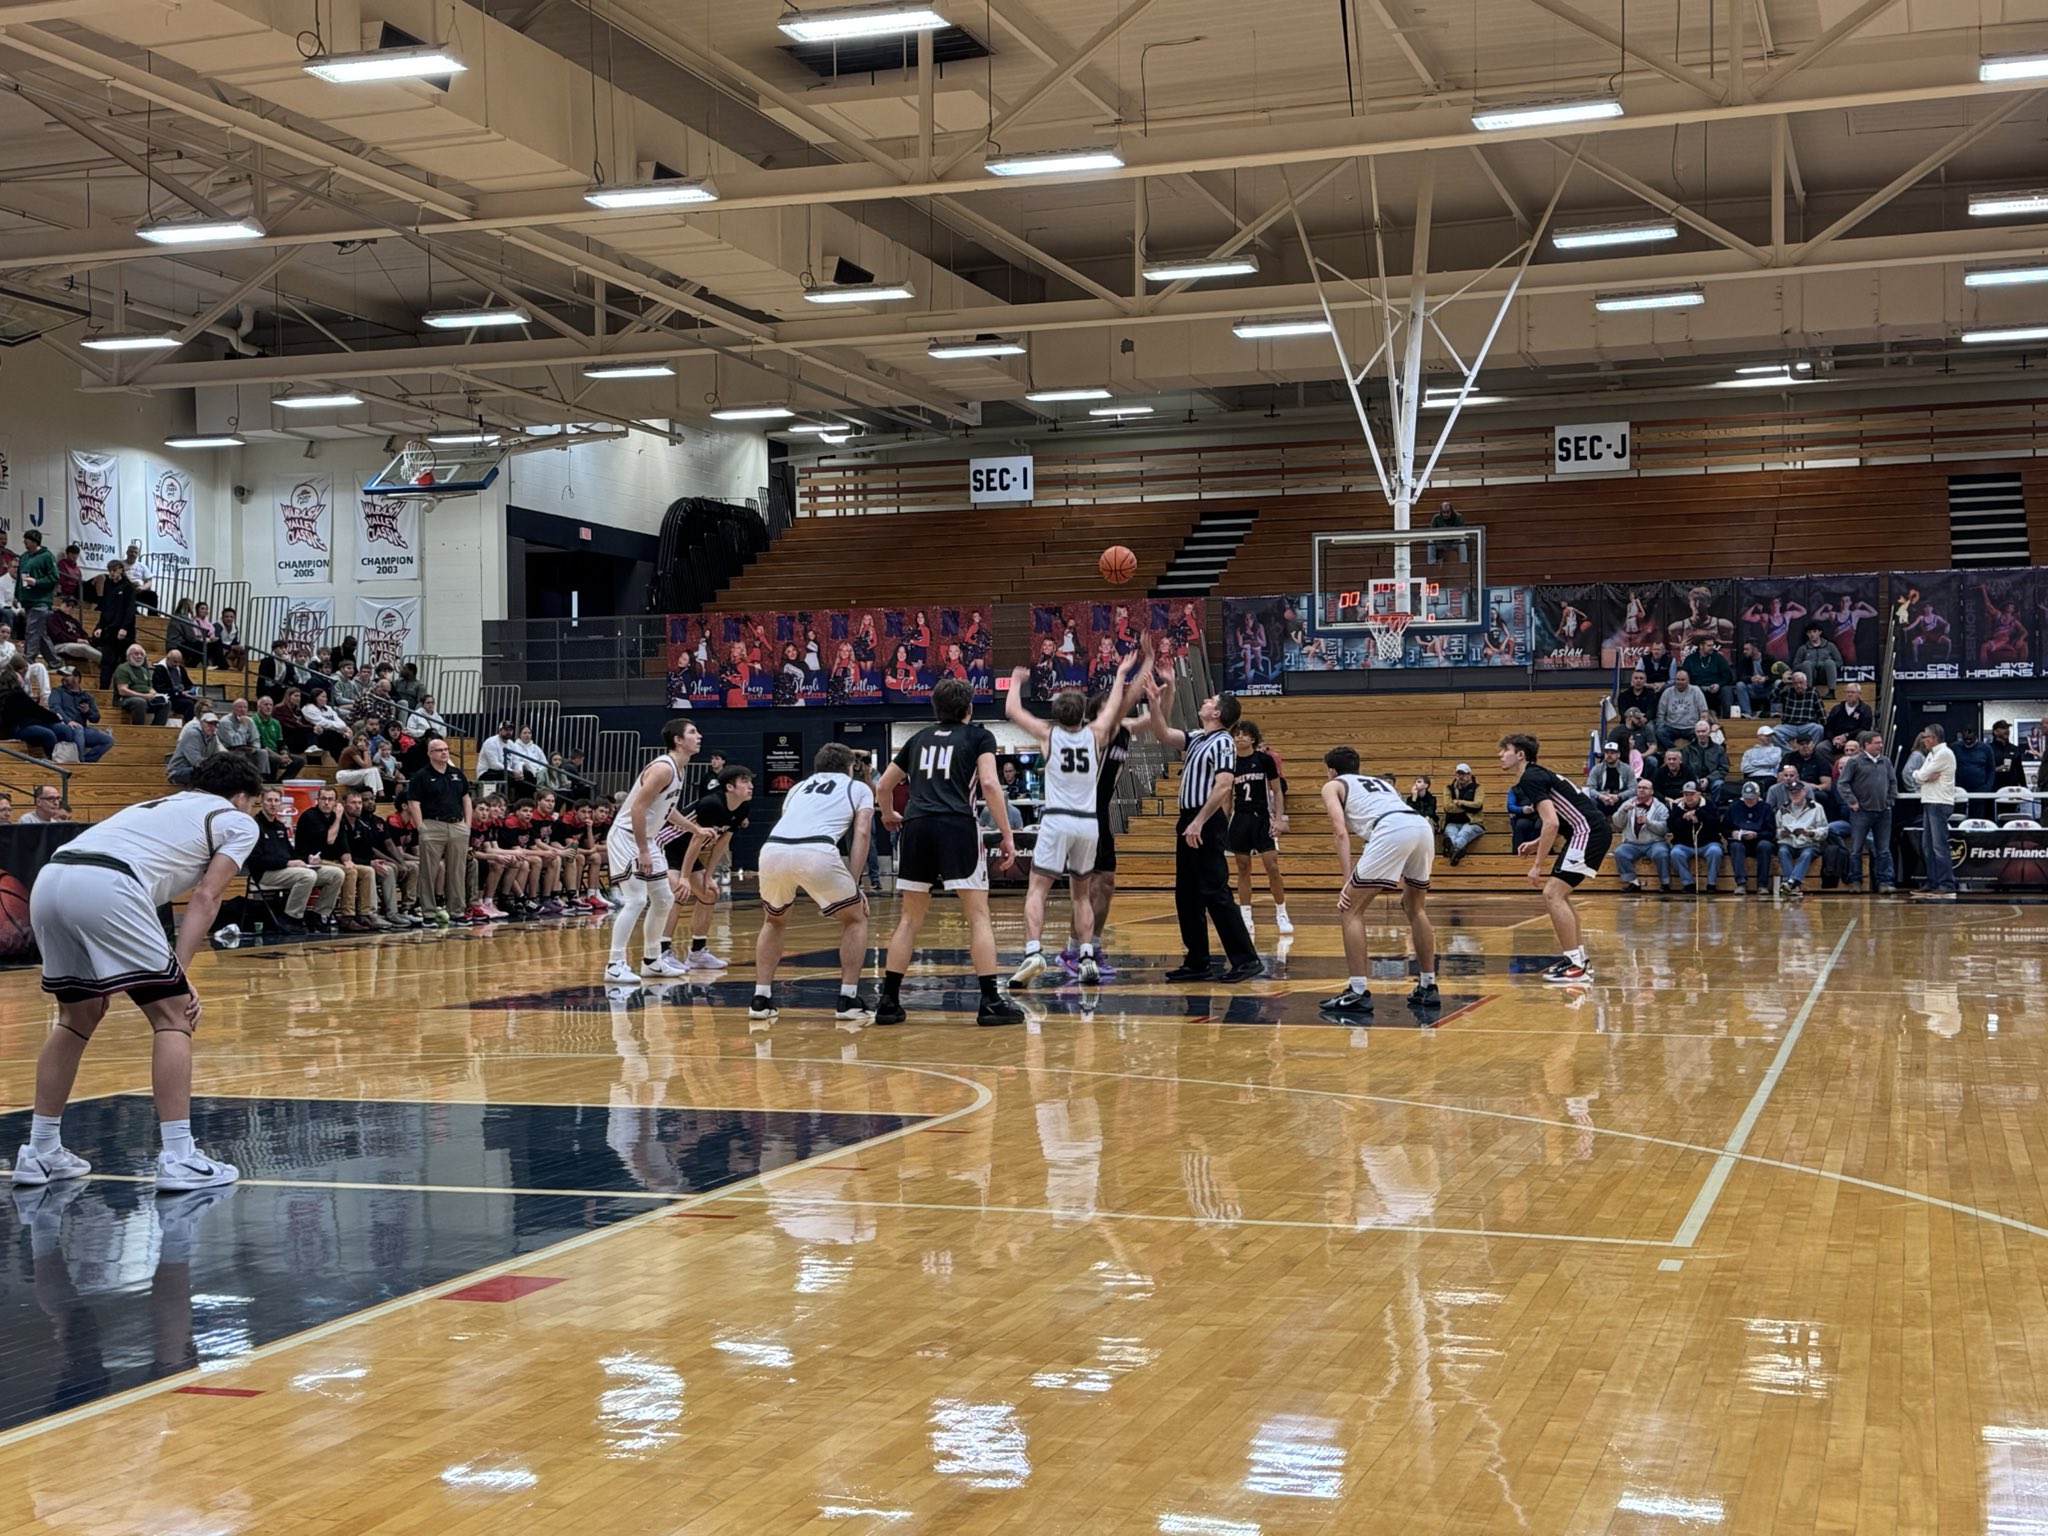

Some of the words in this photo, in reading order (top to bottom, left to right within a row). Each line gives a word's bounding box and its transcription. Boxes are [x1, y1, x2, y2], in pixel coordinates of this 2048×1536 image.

[280, 503, 326, 521] WABASH
[360, 499, 407, 517] WABASH
[284, 517, 317, 534] VALLEY
[364, 515, 398, 530] VALLEY
[286, 528, 328, 552] CLASSIC
[366, 526, 408, 549] CLASSIC
[72, 541, 115, 555] CHAMPION
[85, 552, 104, 562] 2014
[361, 556, 414, 566] CHAMPION
[278, 559, 330, 570] CHAMPION
[376, 565, 398, 575] 2003
[293, 569, 315, 577] 2005
[1284, 652, 1296, 666] 21
[1344, 650, 1357, 664] 32
[1408, 649, 1415, 663] 3
[1550, 647, 1583, 657] ASIAH
[1995, 661, 2034, 669] JEVON
[1050, 669, 1082, 690] Jasmine
[1965, 668, 2034, 678] HAGANS
[690, 679, 713, 695] Hope
[919, 745, 955, 780] 44
[1060, 747, 1090, 774] 35
[1242, 783, 1252, 801] 2
[1357, 778, 1392, 793] 21
[1969, 847, 2001, 858] First
